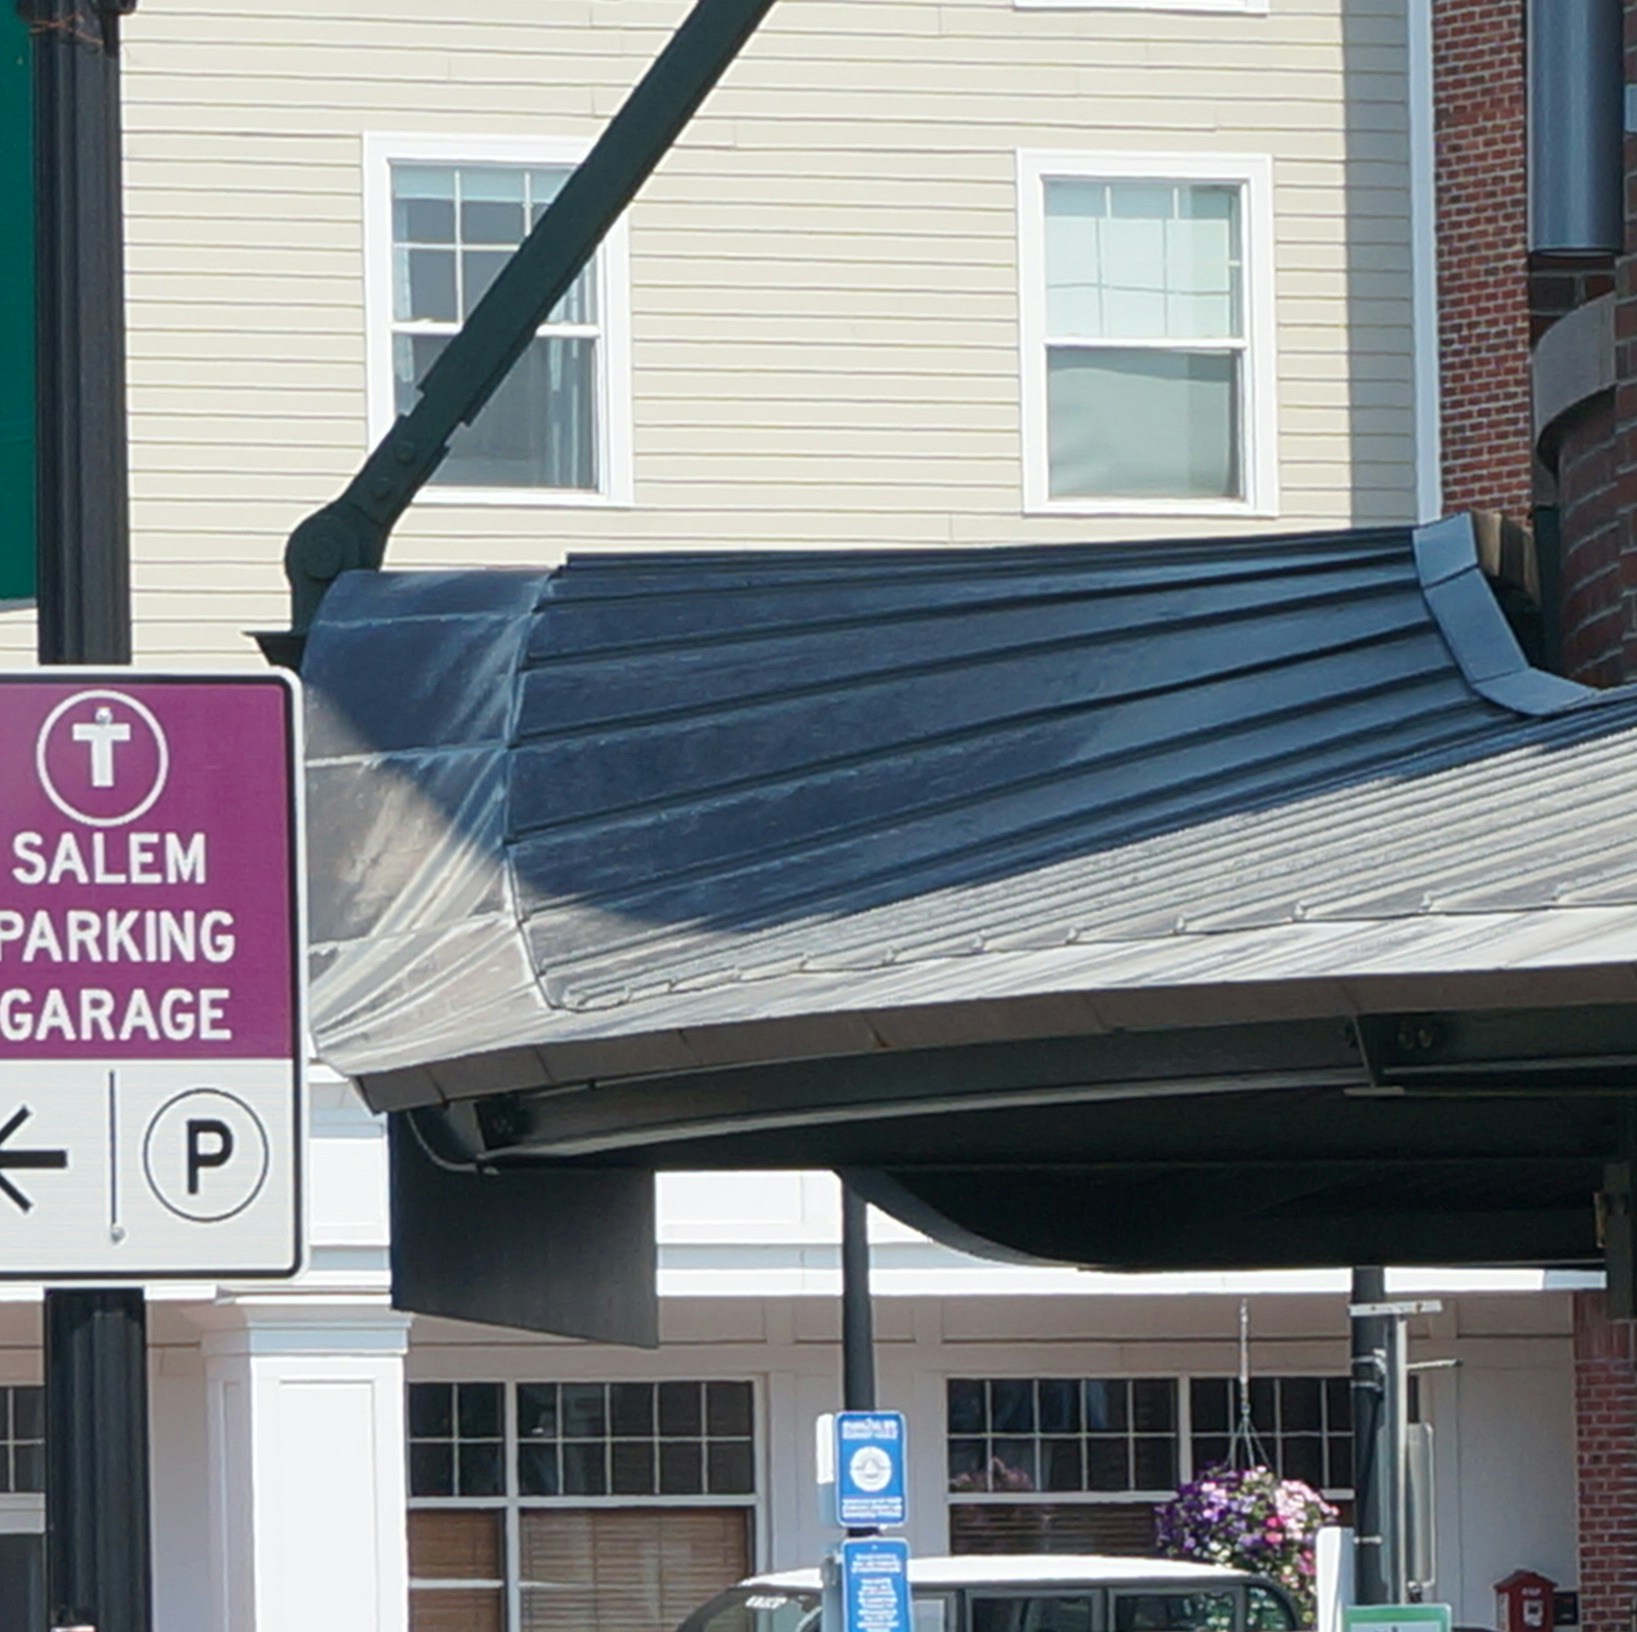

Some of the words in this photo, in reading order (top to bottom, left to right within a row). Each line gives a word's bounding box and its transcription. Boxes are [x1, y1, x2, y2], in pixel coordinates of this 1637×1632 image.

[12, 831, 207, 885] SALEM
[0, 909, 236, 963] PARKING
[0, 987, 233, 1042] GARAGE
[186, 1118, 234, 1195] P
